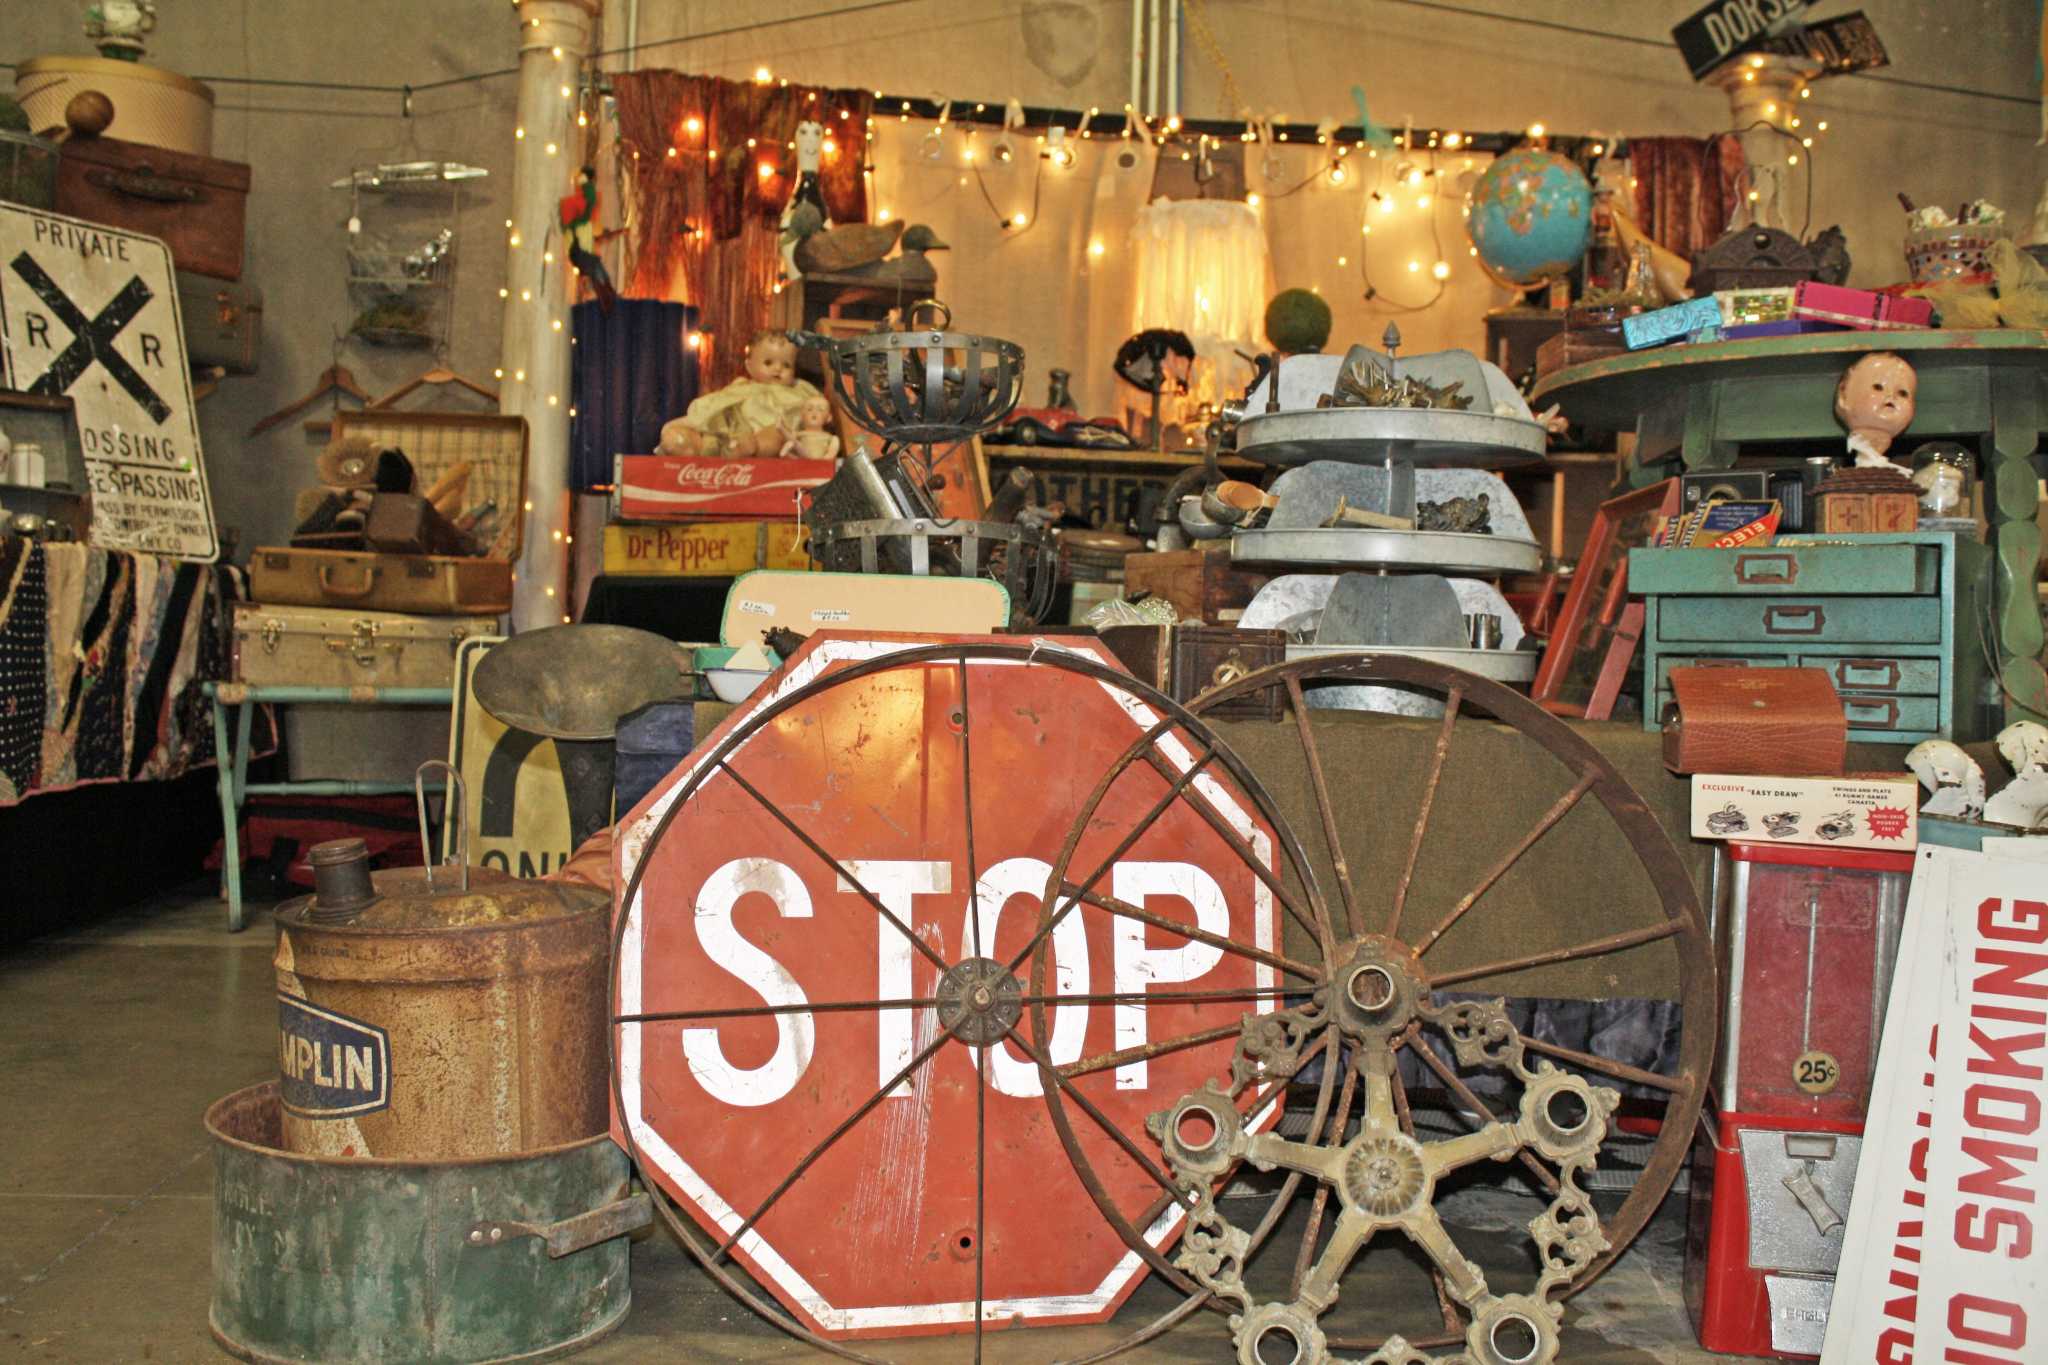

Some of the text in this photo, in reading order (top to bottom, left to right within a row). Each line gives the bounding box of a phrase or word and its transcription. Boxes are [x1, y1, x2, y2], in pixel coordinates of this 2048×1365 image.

[34, 219, 131, 263] PRIVATE
[25, 312, 52, 350] R
[140, 333, 164, 368] R
[85, 427, 175, 461] OSSING
[87, 467, 201, 502] ESPASSING
[677, 463, 756, 489] Coca-Cola
[626, 528, 730, 571] Dr Pepper
[1702, 783, 1745, 792] EXCLUSIVE
[682, 857, 1231, 1107] STOP
[281, 1031, 374, 1092] MPLIN
[1953, 896, 2048, 1261] SMOKING
